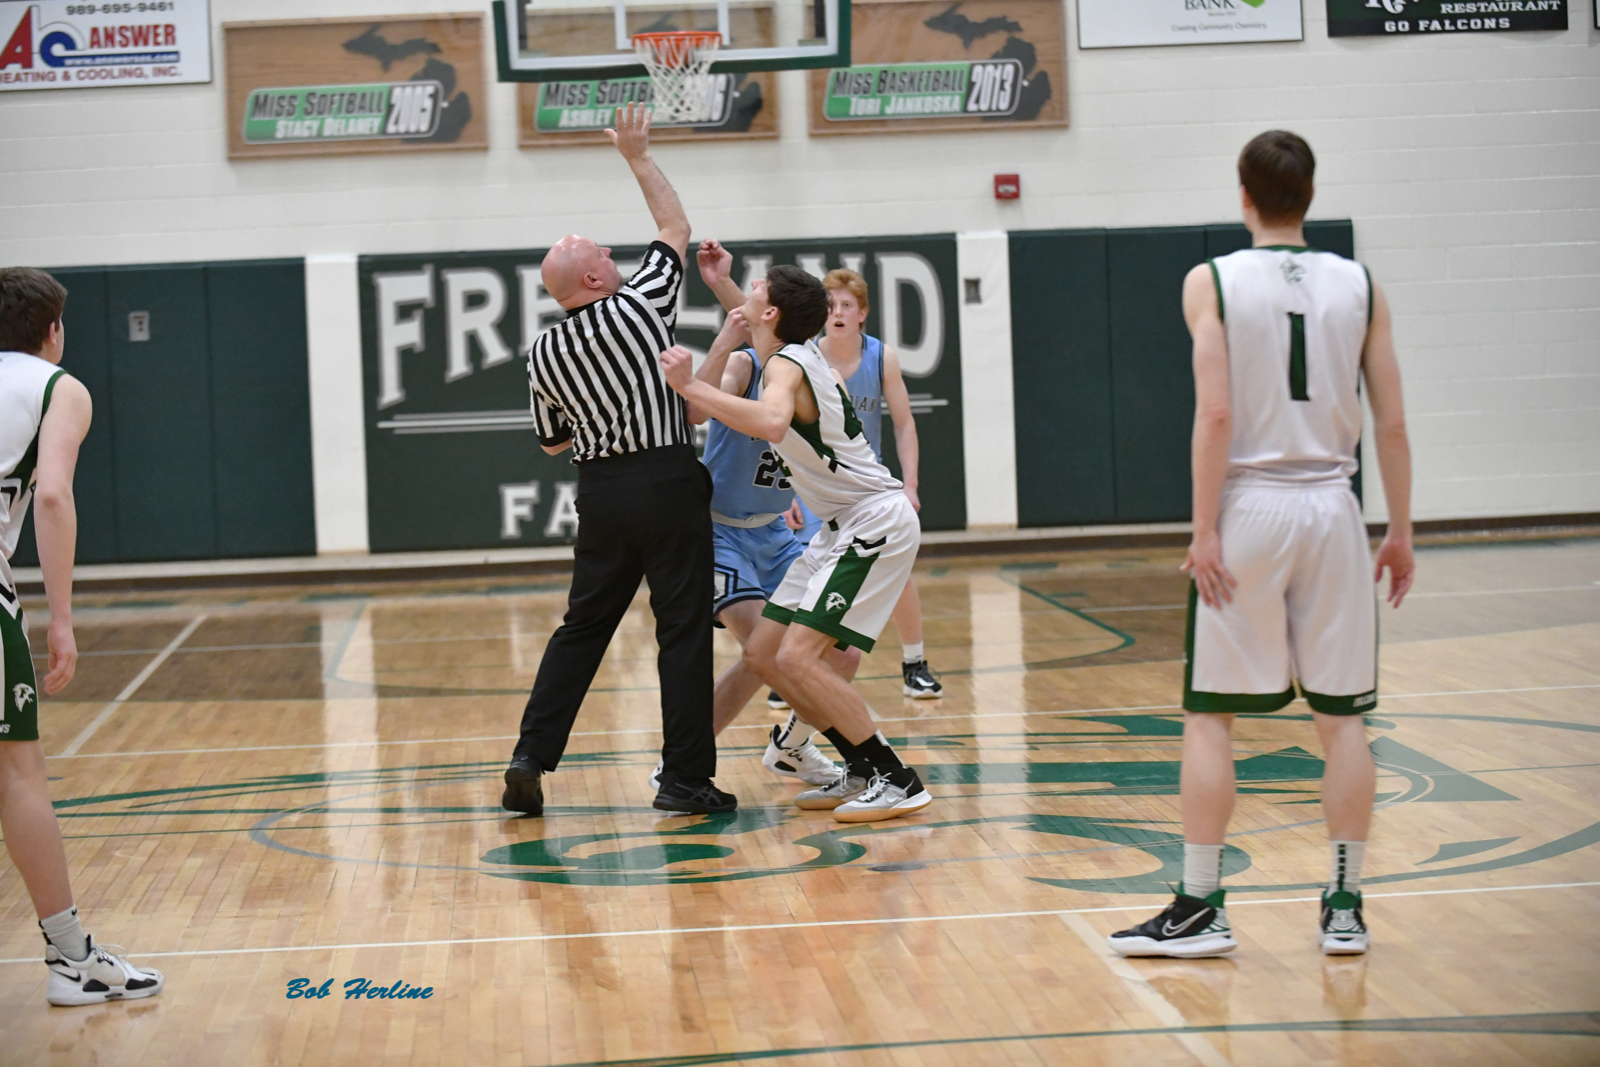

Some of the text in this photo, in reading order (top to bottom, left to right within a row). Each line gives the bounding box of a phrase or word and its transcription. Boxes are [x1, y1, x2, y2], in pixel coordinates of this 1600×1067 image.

[66, 2, 174, 15] 989-695-9461
[1440, 0, 1561, 14] RESTAURANT
[90, 24, 176, 49] ANSWER
[1384, 18, 1511, 32] GO FALCONS
[0, 71, 57, 84] EATING
[61, 71, 71, 81] &
[833, 68, 966, 97] MISS BASKETBALL
[966, 63, 1015, 113] 2013
[252, 91, 385, 120] MISS SOFTBALL
[544, 82, 590, 108] MISS
[1286, 311, 1311, 402] 1
